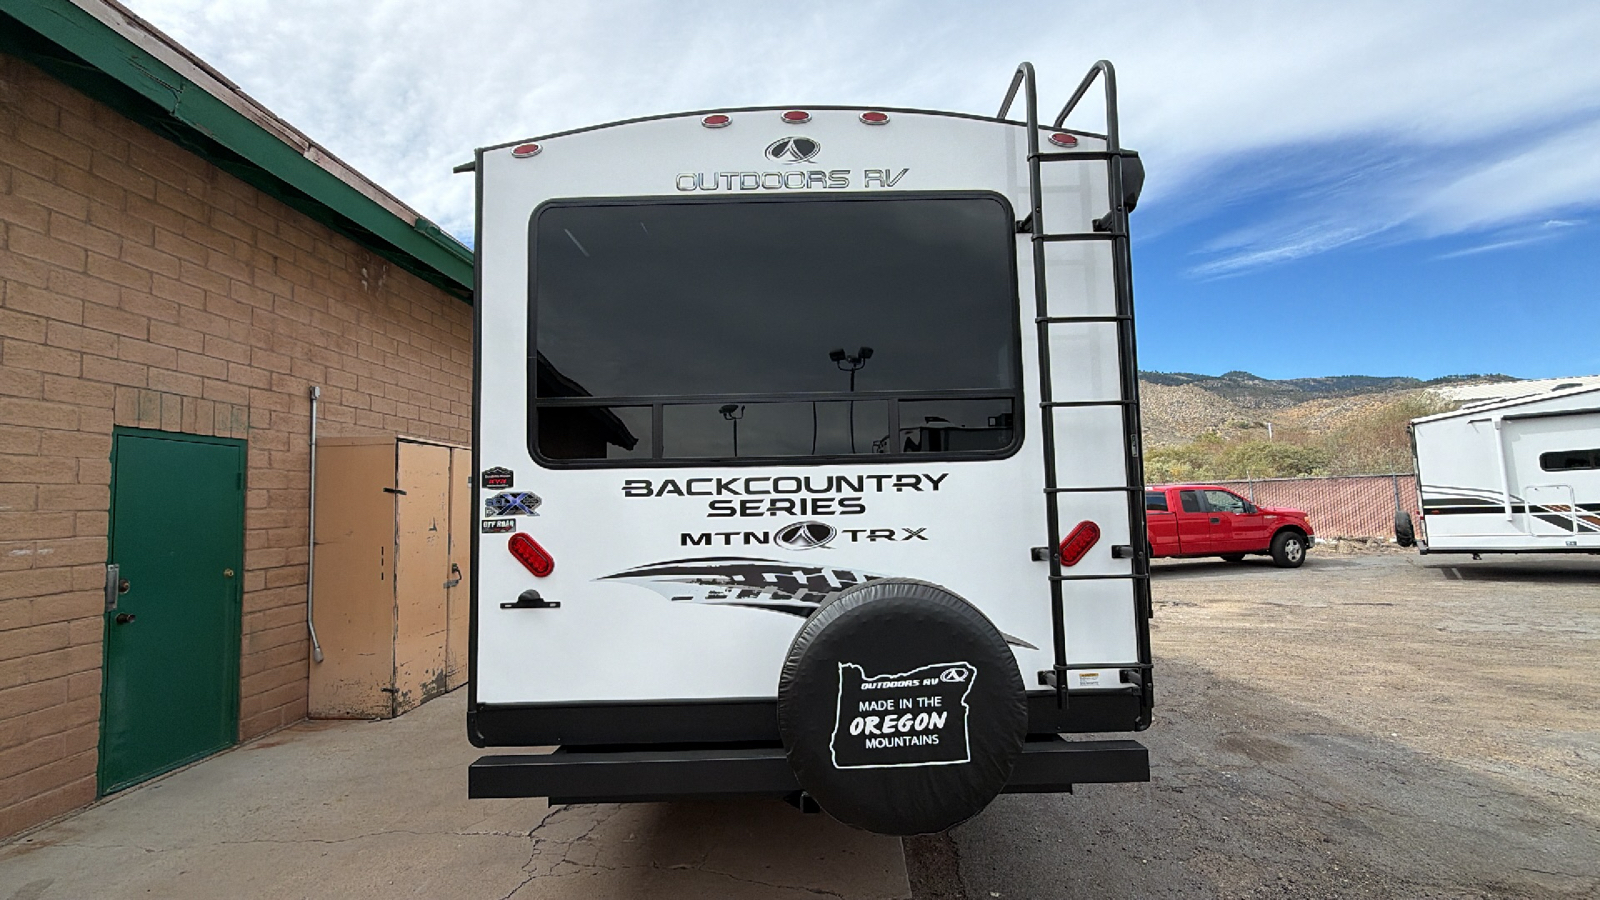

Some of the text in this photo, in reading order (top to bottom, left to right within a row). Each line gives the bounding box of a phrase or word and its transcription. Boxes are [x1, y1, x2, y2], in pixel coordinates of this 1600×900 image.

[675, 168, 910, 192] OUTDOORS RV
[621, 473, 949, 497] BACKCOUNTRY
[706, 497, 866, 518] SERIES
[680, 528, 929, 546] MTN TRX
[860, 677, 939, 690] OUTDOORS RV
[859, 696, 942, 712] MADE IN THE
[849, 711, 948, 736] OREGON
[865, 734, 939, 749] MOUNTAINS
